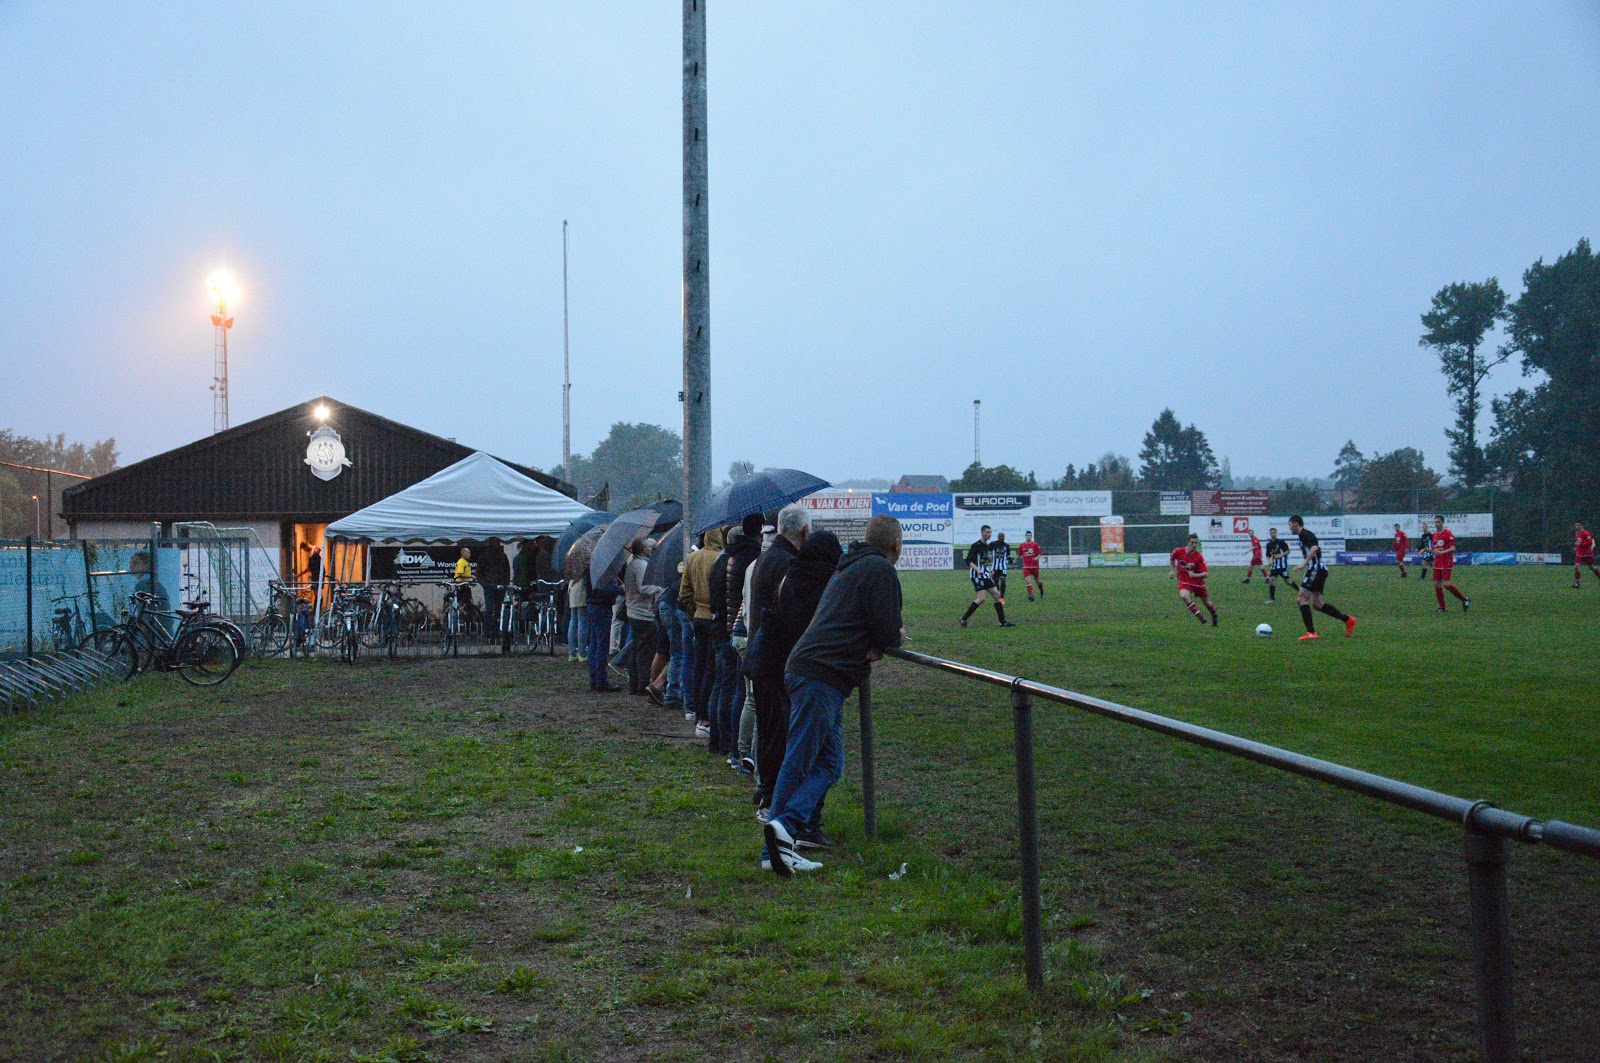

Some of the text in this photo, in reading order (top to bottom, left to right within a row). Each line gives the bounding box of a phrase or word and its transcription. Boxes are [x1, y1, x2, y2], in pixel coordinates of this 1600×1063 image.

[816, 499, 834, 508] VAN
[837, 499, 870, 508] OLMEN
[888, 502, 950, 512] Van de Poel
[901, 523, 945, 532] WORLD
[901, 547, 949, 556] RTERSCLUB
